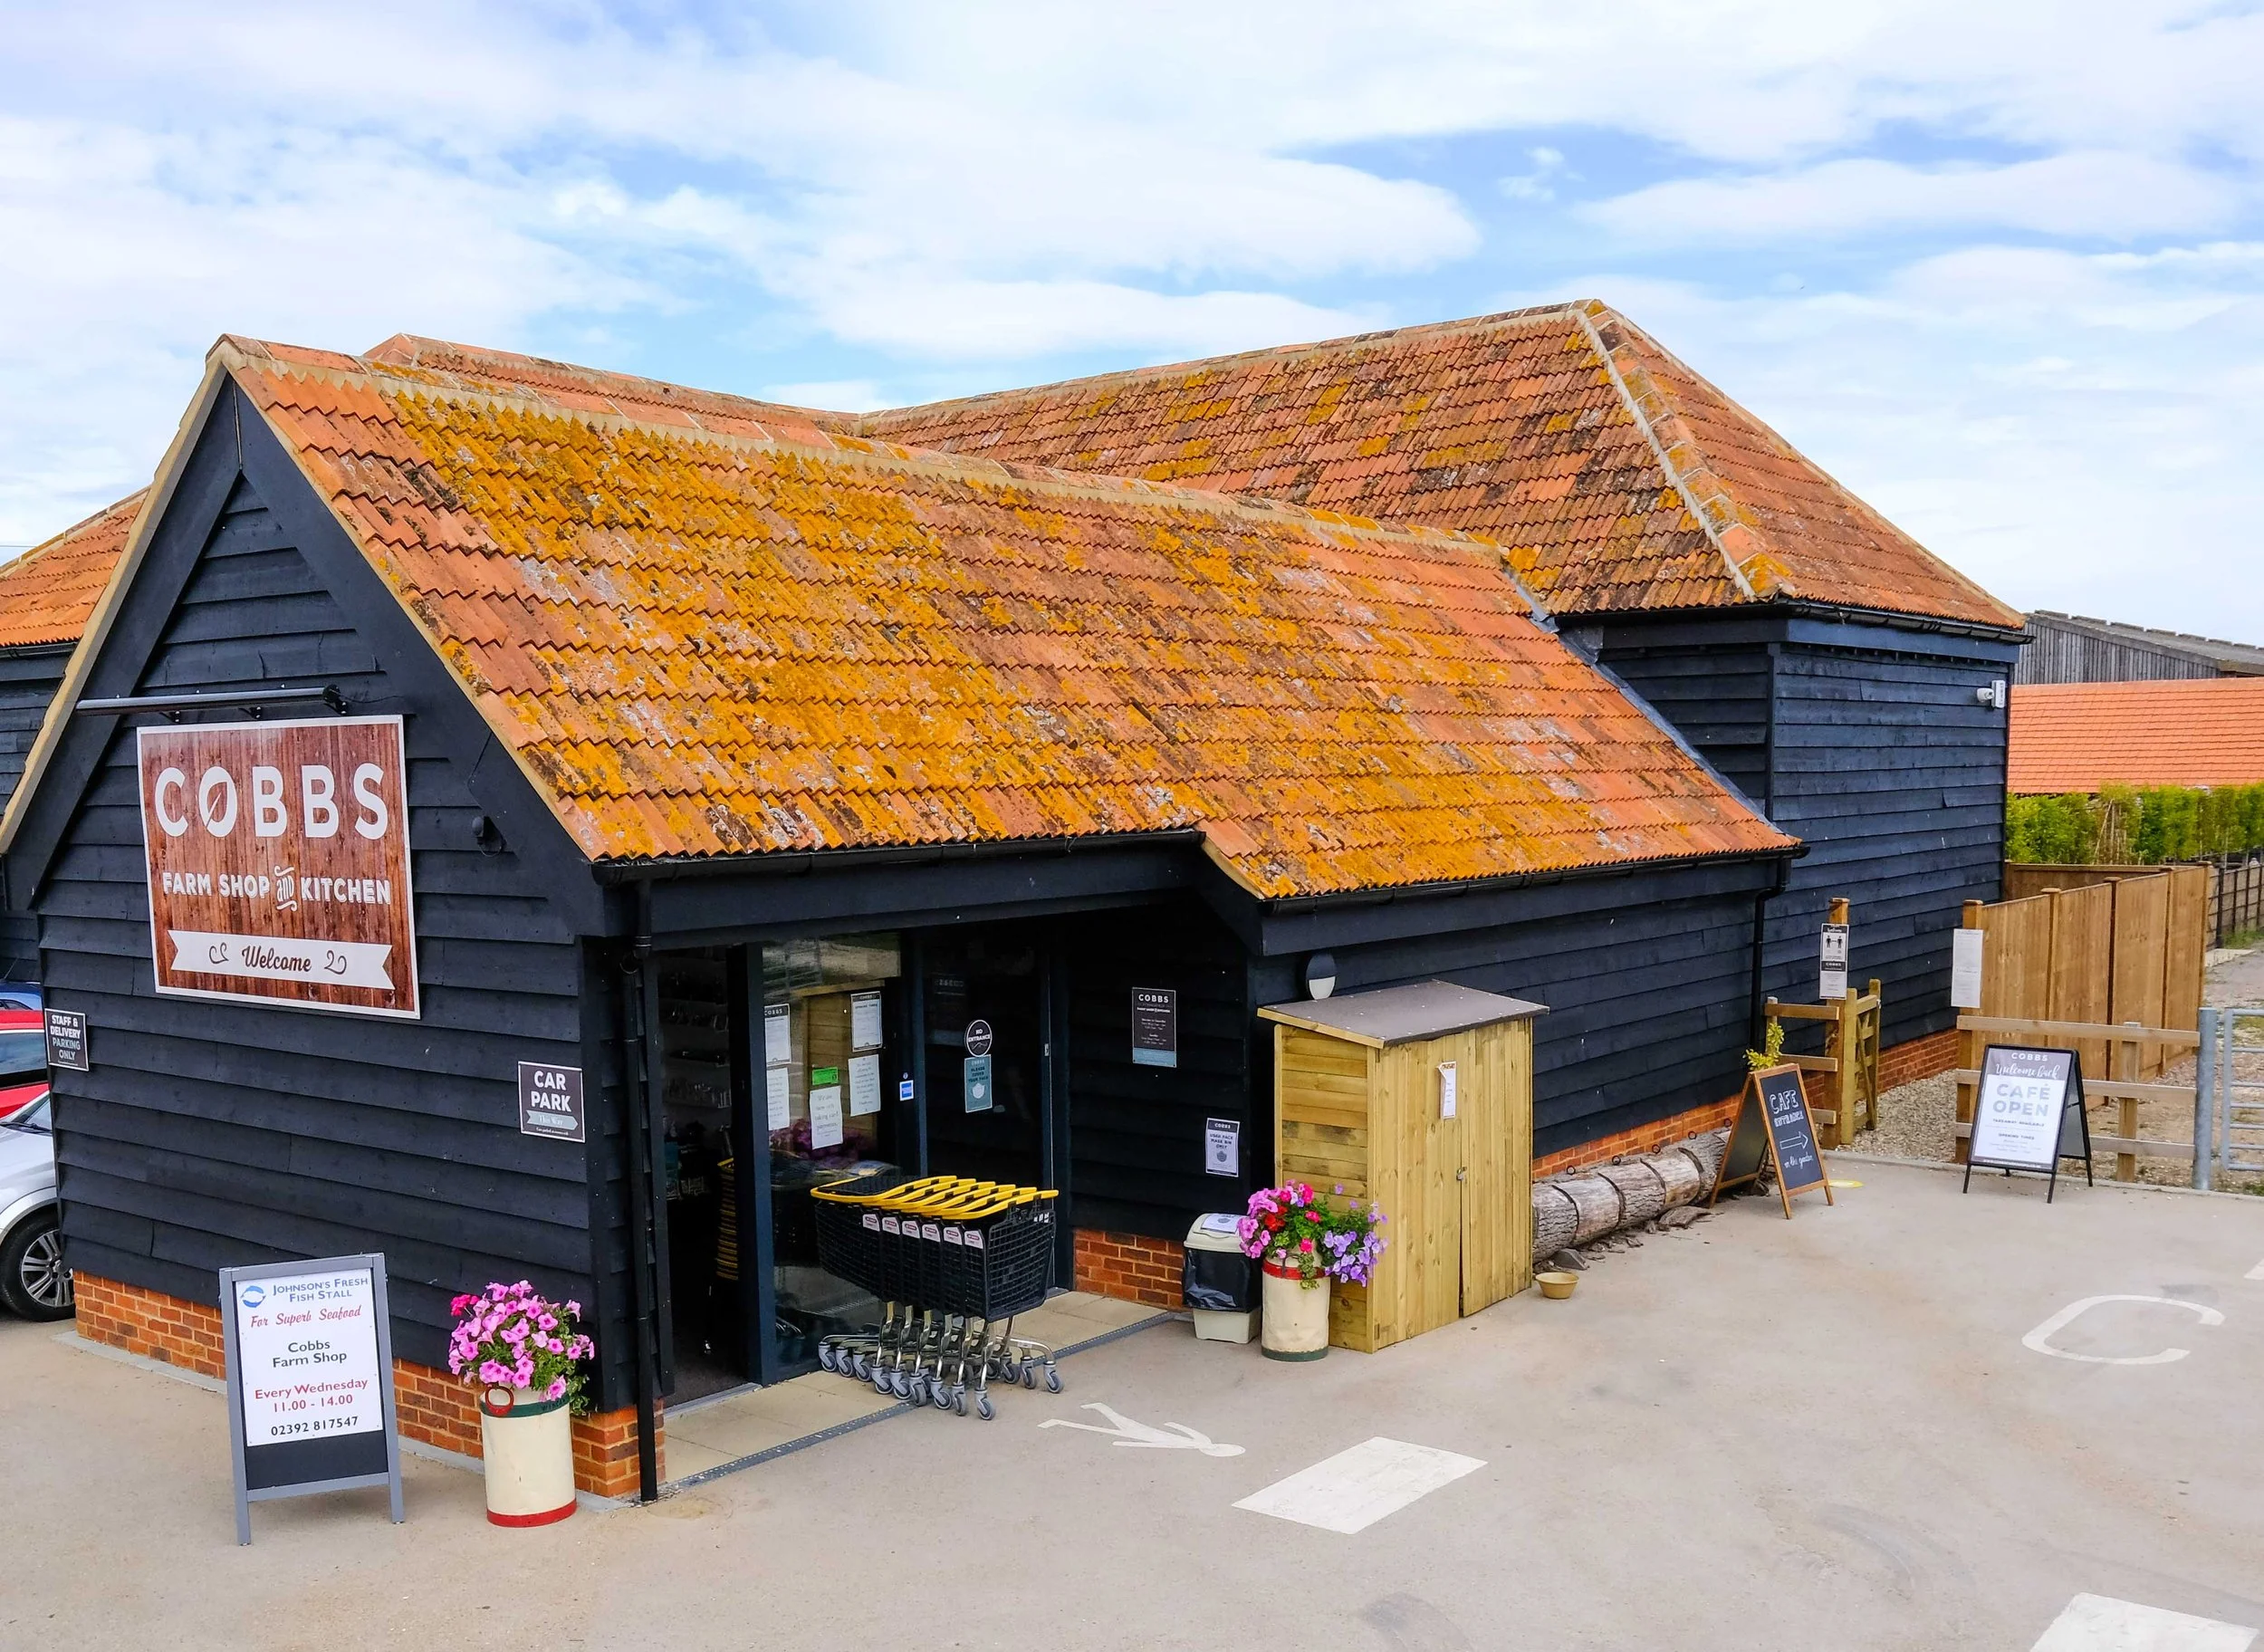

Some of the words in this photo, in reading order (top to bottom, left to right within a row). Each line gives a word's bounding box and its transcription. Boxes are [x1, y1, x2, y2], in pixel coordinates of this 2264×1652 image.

[155, 762, 388, 840] COBBS
[162, 872, 211, 896] FARM
[218, 873, 270, 898] SHOP
[275, 869, 296, 907] and
[301, 877, 390, 905] KITCHEN
[242, 945, 312, 973] Welcome
[1138, 994, 1169, 1004] COBBS
[52, 1014, 72, 1026] STAFF
[72, 1017, 78, 1027] &
[50, 1025, 82, 1039] DELIVERY
[968, 1034, 991, 1042] ENTRANCE
[53, 1037, 81, 1050] PARKING
[59, 1050, 76, 1061] ONLY
[2011, 1052, 2048, 1062] COBBS
[534, 1071, 566, 1090] CAR
[2035, 1065, 2060, 1080] back
[1996, 1083, 2051, 1100] CAFÉ
[531, 1090, 571, 1112] PARK
[1770, 1090, 1799, 1114] CAFE
[1992, 1100, 2049, 1117] OPEN
[273, 1280, 331, 1296] JOHNSON'S
[334, 1277, 369, 1289] FRESH
[289, 1292, 314, 1302] FISH
[318, 1290, 352, 1300] STALL
[250, 1315, 269, 1328] For
[275, 1310, 312, 1327] Superb
[319, 1304, 362, 1321] Seafood
[288, 1340, 331, 1353] Cobbs
[273, 1356, 309, 1368] Farm
[313, 1351, 347, 1364] Shop
[254, 1387, 292, 1400] Every
[294, 1379, 369, 1394] Wednesday
[273, 1399, 306, 1413] 11.00
[321, 1394, 353, 1407] 14.00
[271, 1422, 309, 1436] 02392
[313, 1416, 359, 1431] 817547
